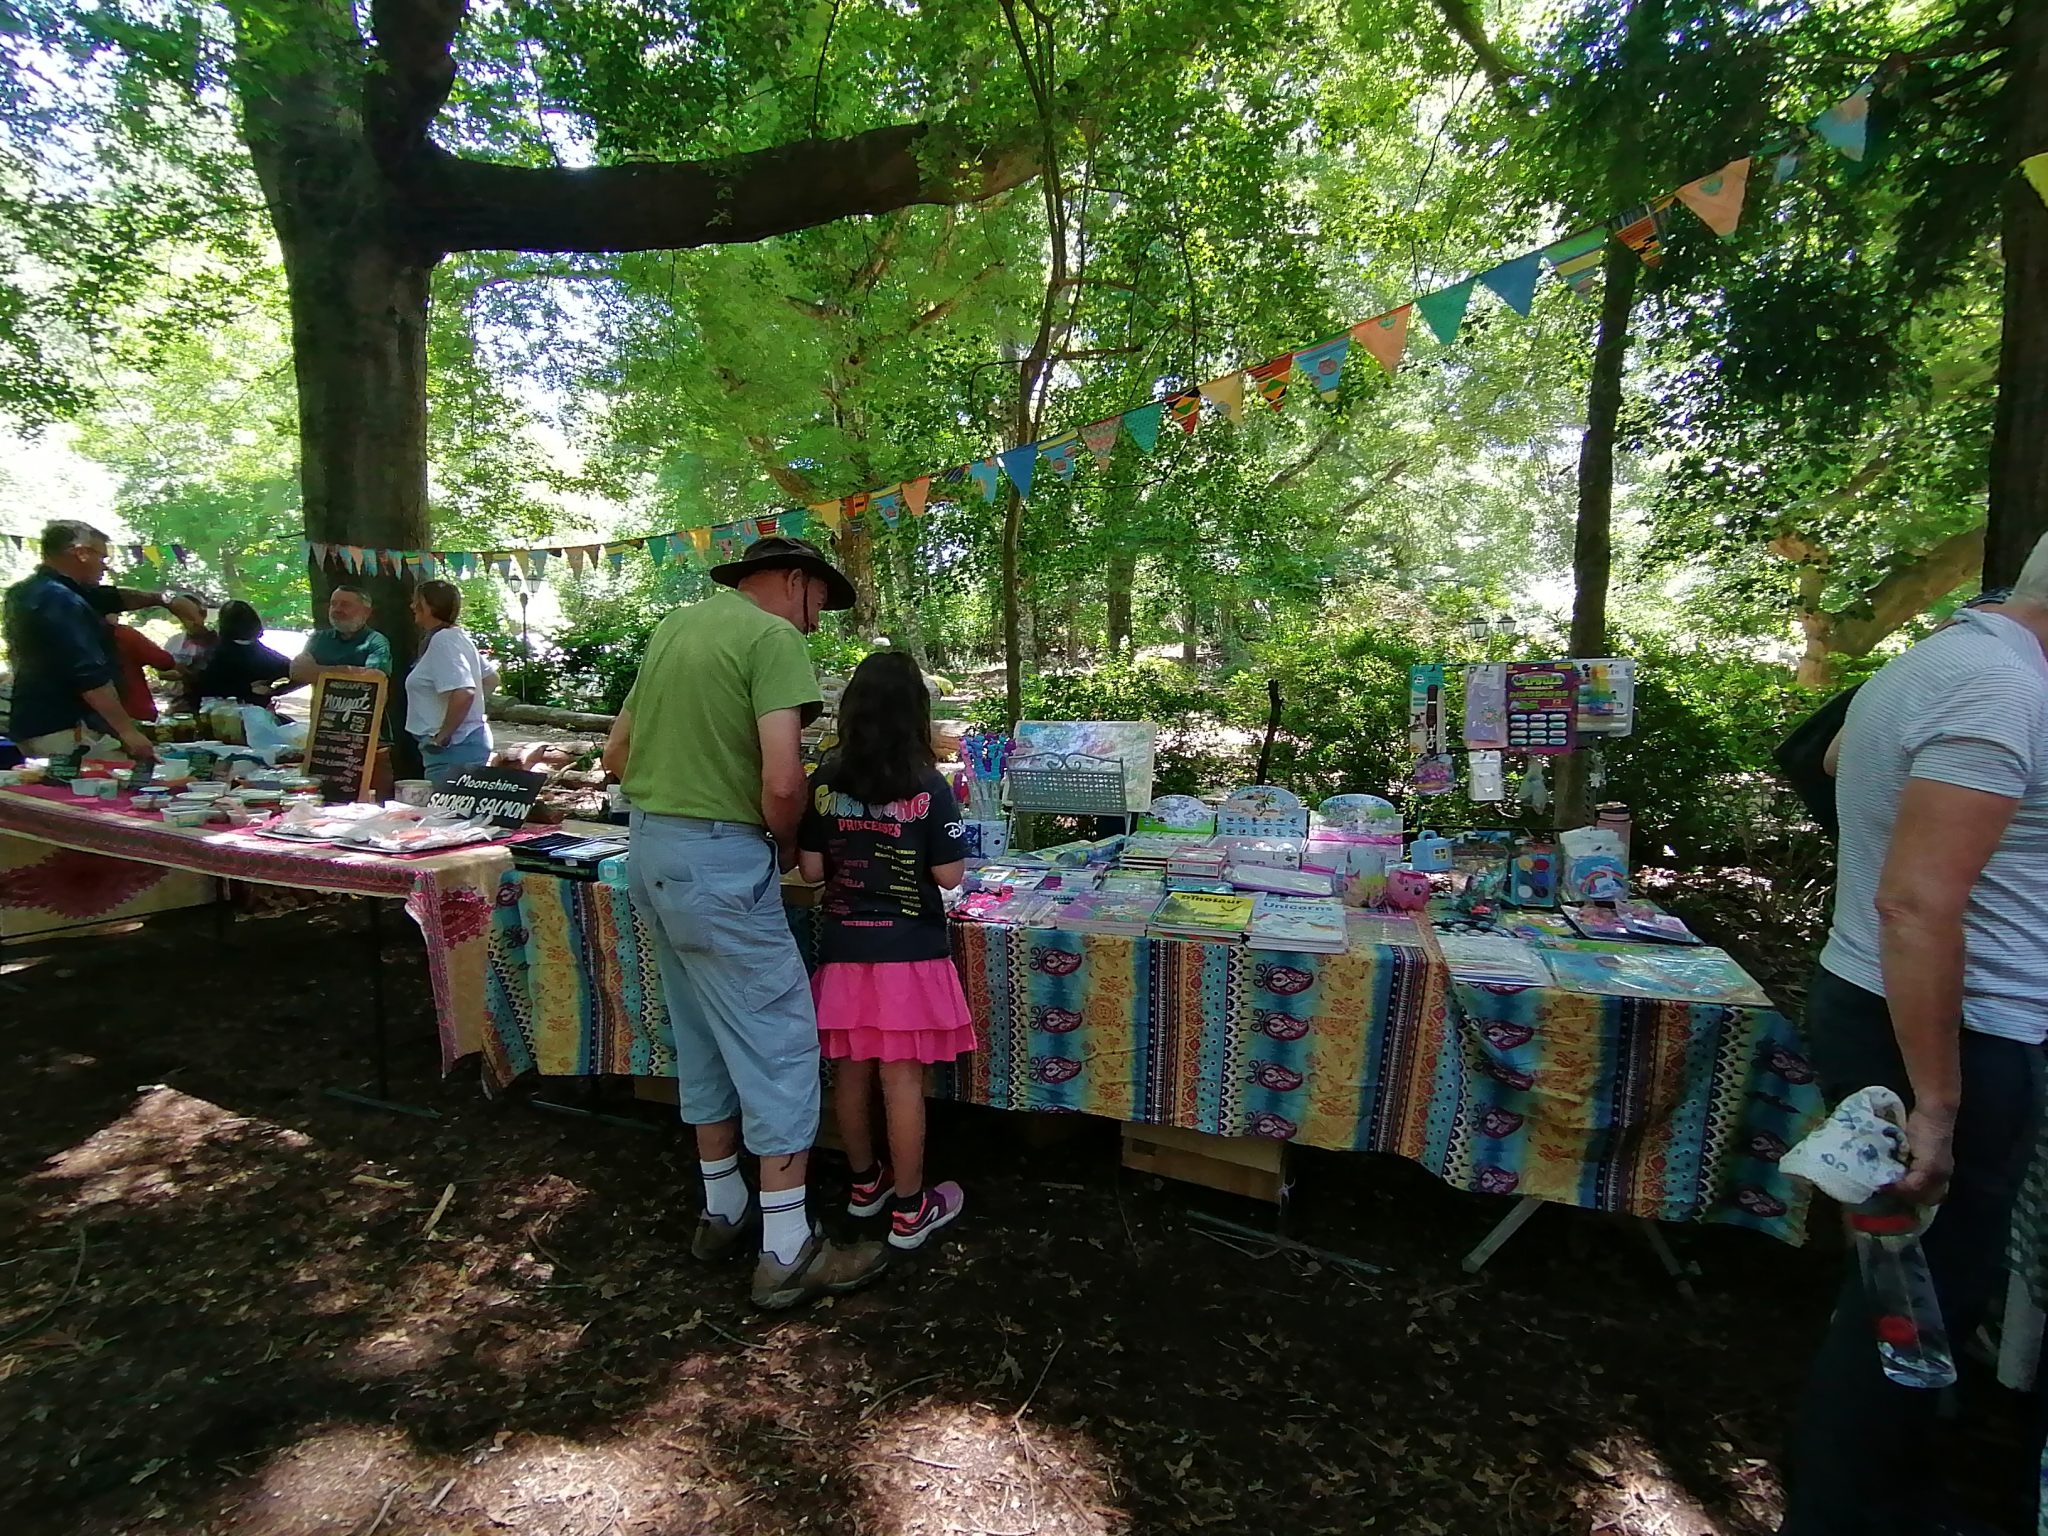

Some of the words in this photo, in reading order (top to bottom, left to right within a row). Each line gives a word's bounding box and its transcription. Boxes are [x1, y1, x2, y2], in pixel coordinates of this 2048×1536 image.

[427, 792, 475, 812] SMOKED
[475, 797, 531, 820] SALMON
[1263, 901, 1333, 912] Unicorns
